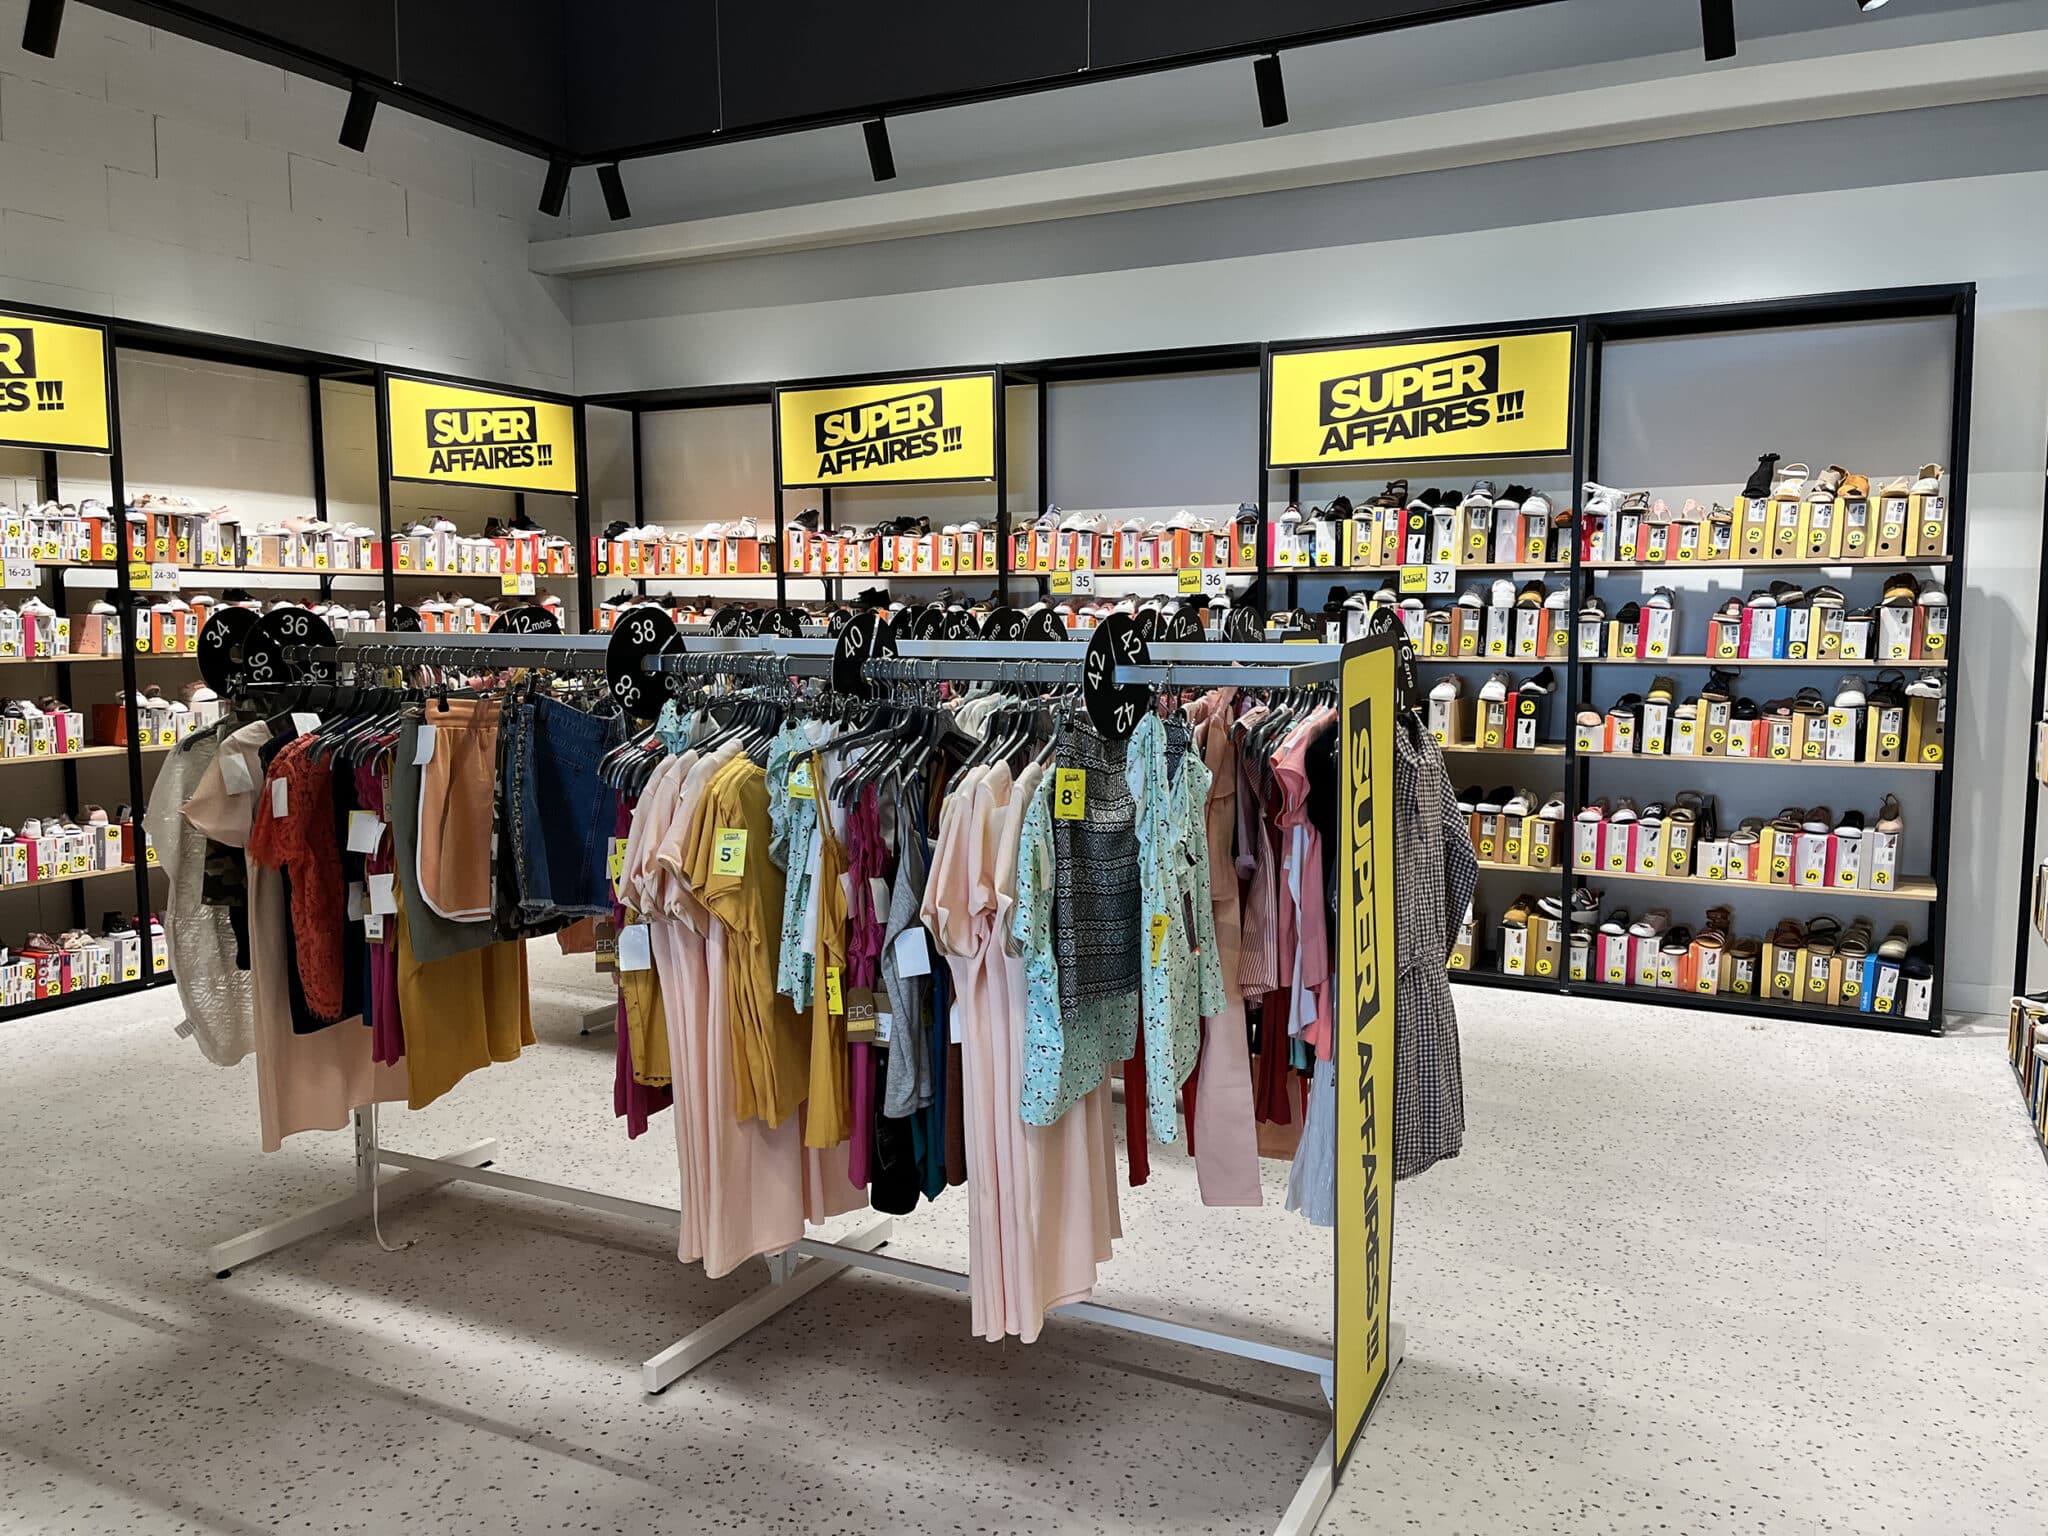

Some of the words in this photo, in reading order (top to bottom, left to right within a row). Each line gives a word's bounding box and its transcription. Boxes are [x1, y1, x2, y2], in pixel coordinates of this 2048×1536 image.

[1330, 355, 1486, 419] SUPER
[433, 410, 531, 444] SUPER
[823, 394, 935, 447] SUPER
[1319, 398, 1490, 456] AFFAIRES
[429, 445, 535, 474] AFFAIRES
[817, 431, 938, 479] AFFAIRES
[8, 568, 31, 576] 16-23
[1076, 575, 1090, 587] 35
[1205, 574, 1220, 586] 36
[1433, 571, 1449, 584] 37
[206, 619, 230, 648] 34
[280, 614, 308, 636] 36
[630, 619, 656, 644] 38
[844, 625, 863, 659] 40
[1121, 629, 1142, 664] 42
[248, 652, 272, 681] 36
[1088, 650, 1106, 690] 42
[615, 675, 641, 707] 38
[1114, 702, 1135, 734] 42
[1351, 727, 1377, 1016] SUPER
[1357, 1041, 1380, 1321] AFFAIRES
